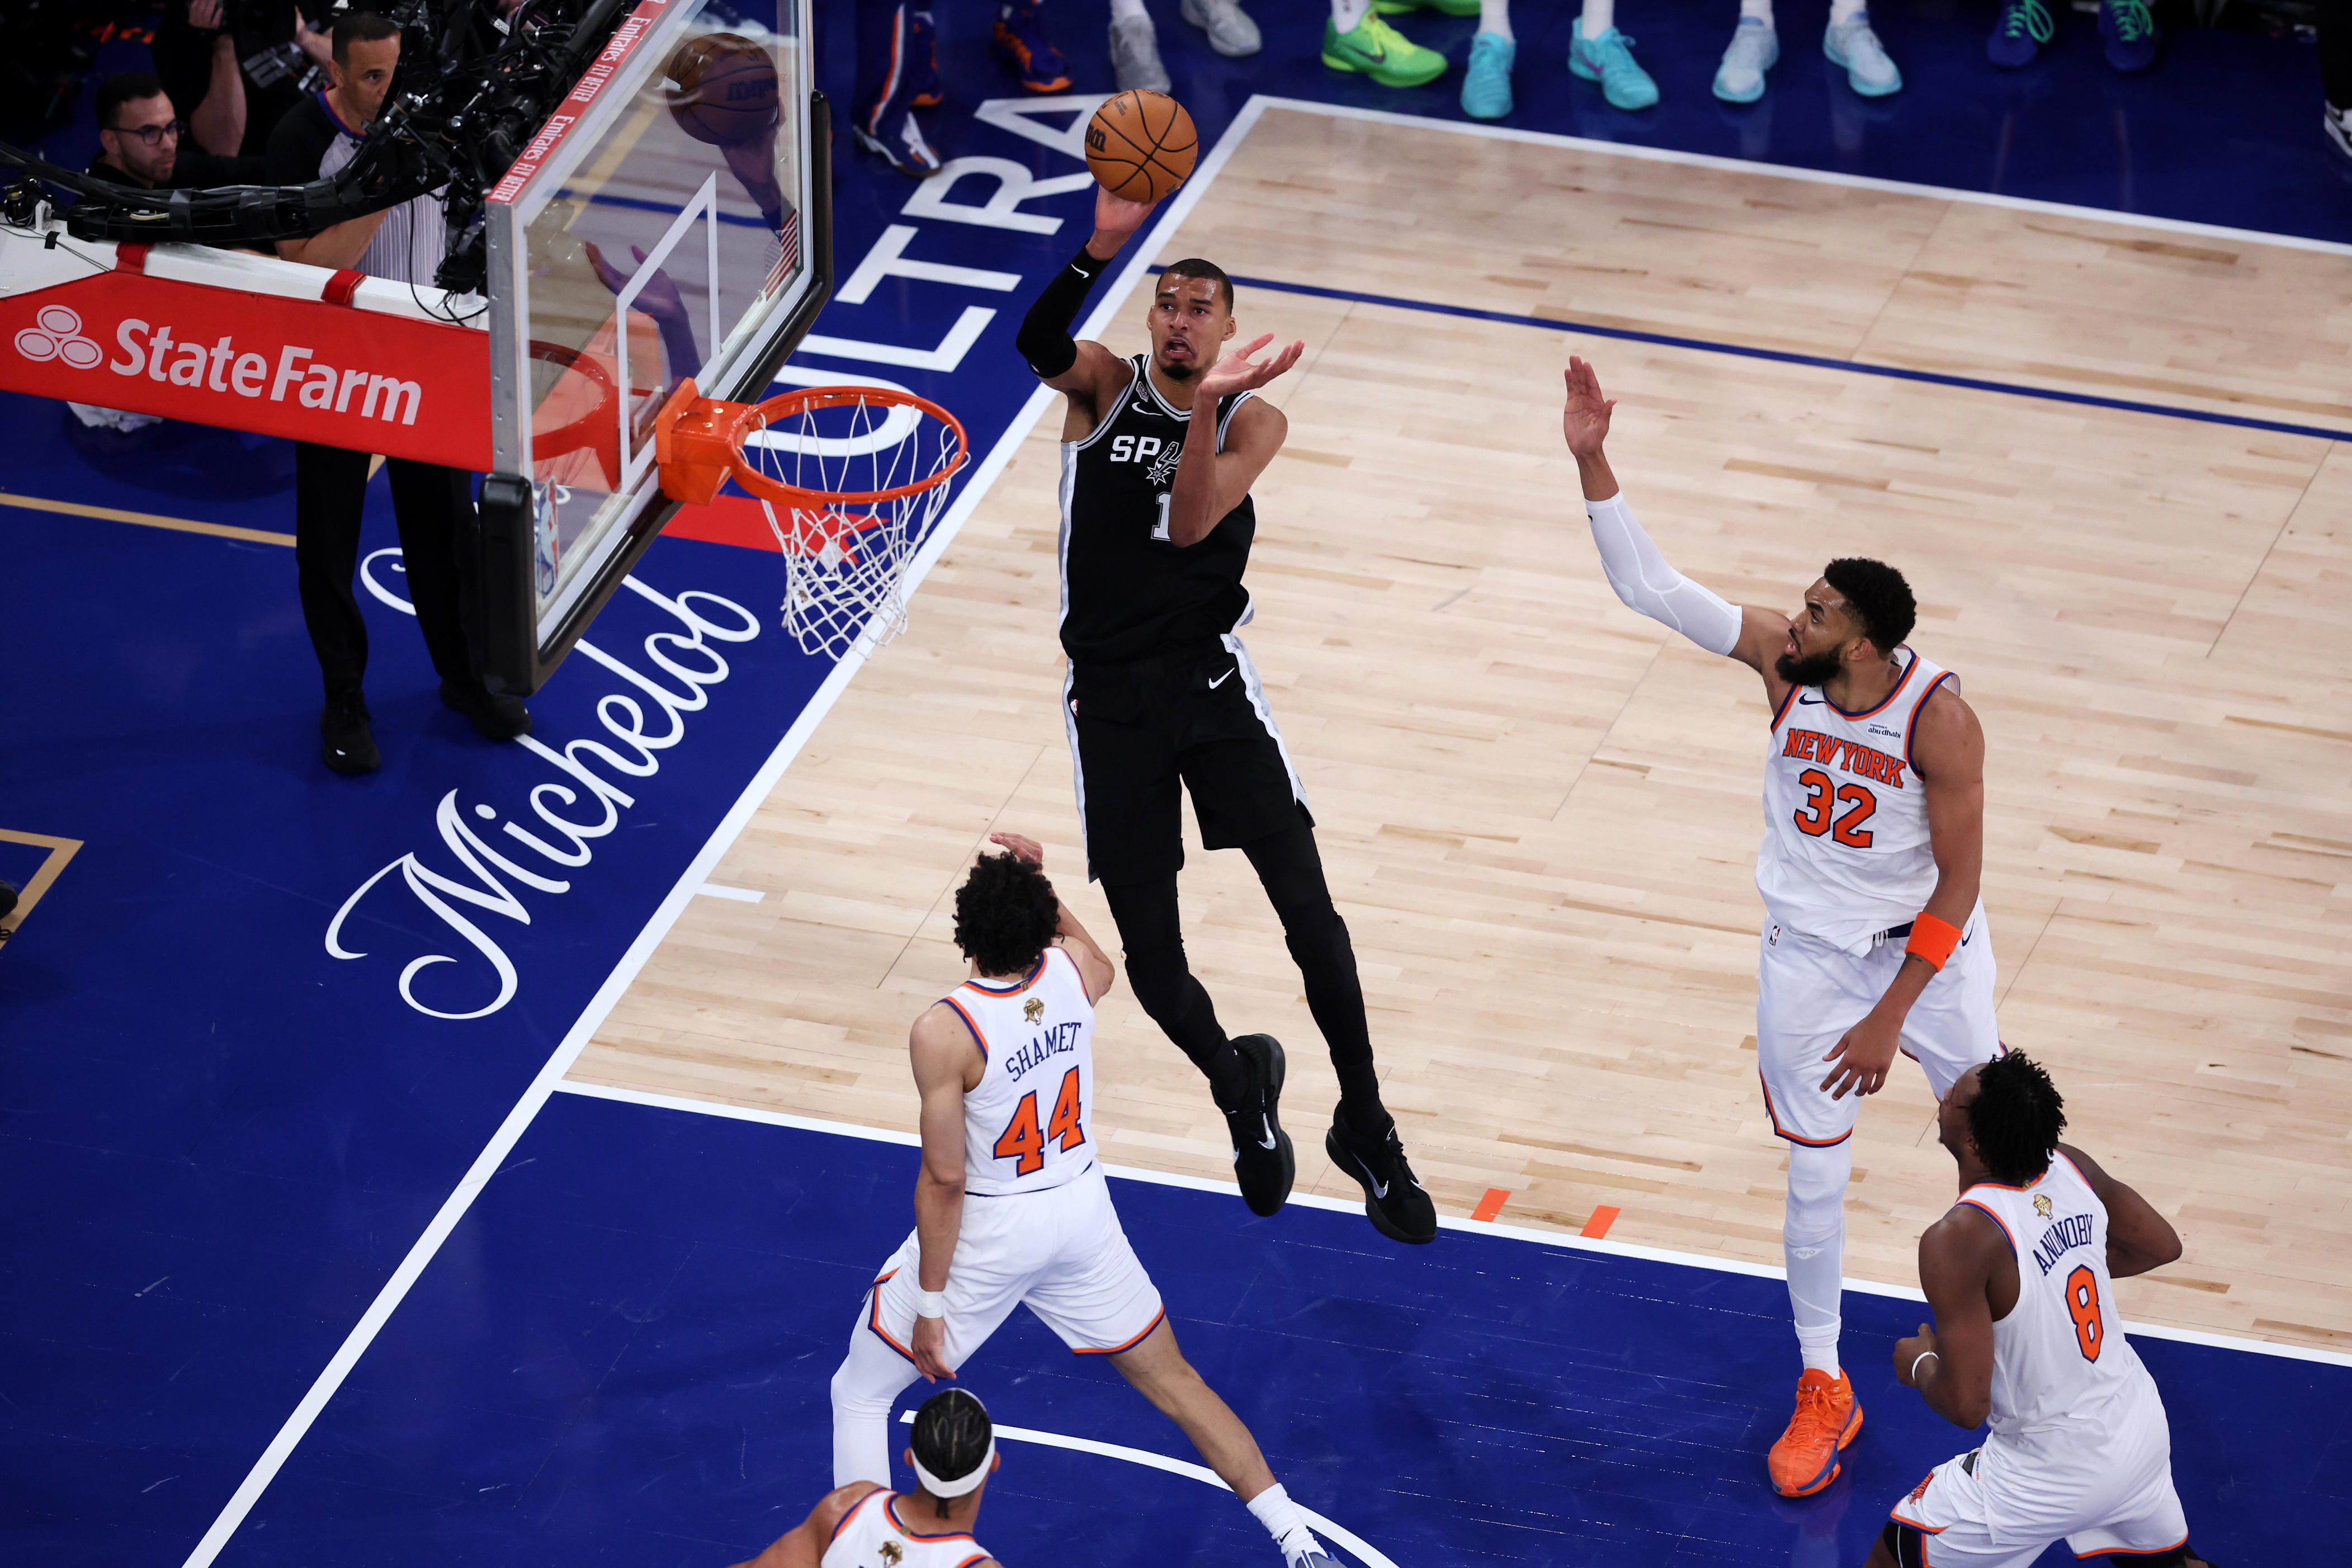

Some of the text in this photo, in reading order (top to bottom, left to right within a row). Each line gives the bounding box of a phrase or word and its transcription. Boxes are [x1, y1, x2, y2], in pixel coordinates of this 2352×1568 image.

[569, 17, 652, 103] Emirates FLY BETTER
[490, 115, 576, 201] Emirates FLY BETTER
[1150, 491, 1172, 541] 1
[324, 92, 1118, 1021] Michelob ULTRA
[1782, 728, 1907, 789] NEW YORK
[1881, 729, 1901, 739] dhabi
[1793, 768, 1877, 848] 32
[1005, 1022, 1081, 1083] SHAMET
[993, 1064, 1086, 1178] 44
[2033, 1213, 2093, 1277] ANUNOBY
[2065, 1263, 2104, 1364] 8
